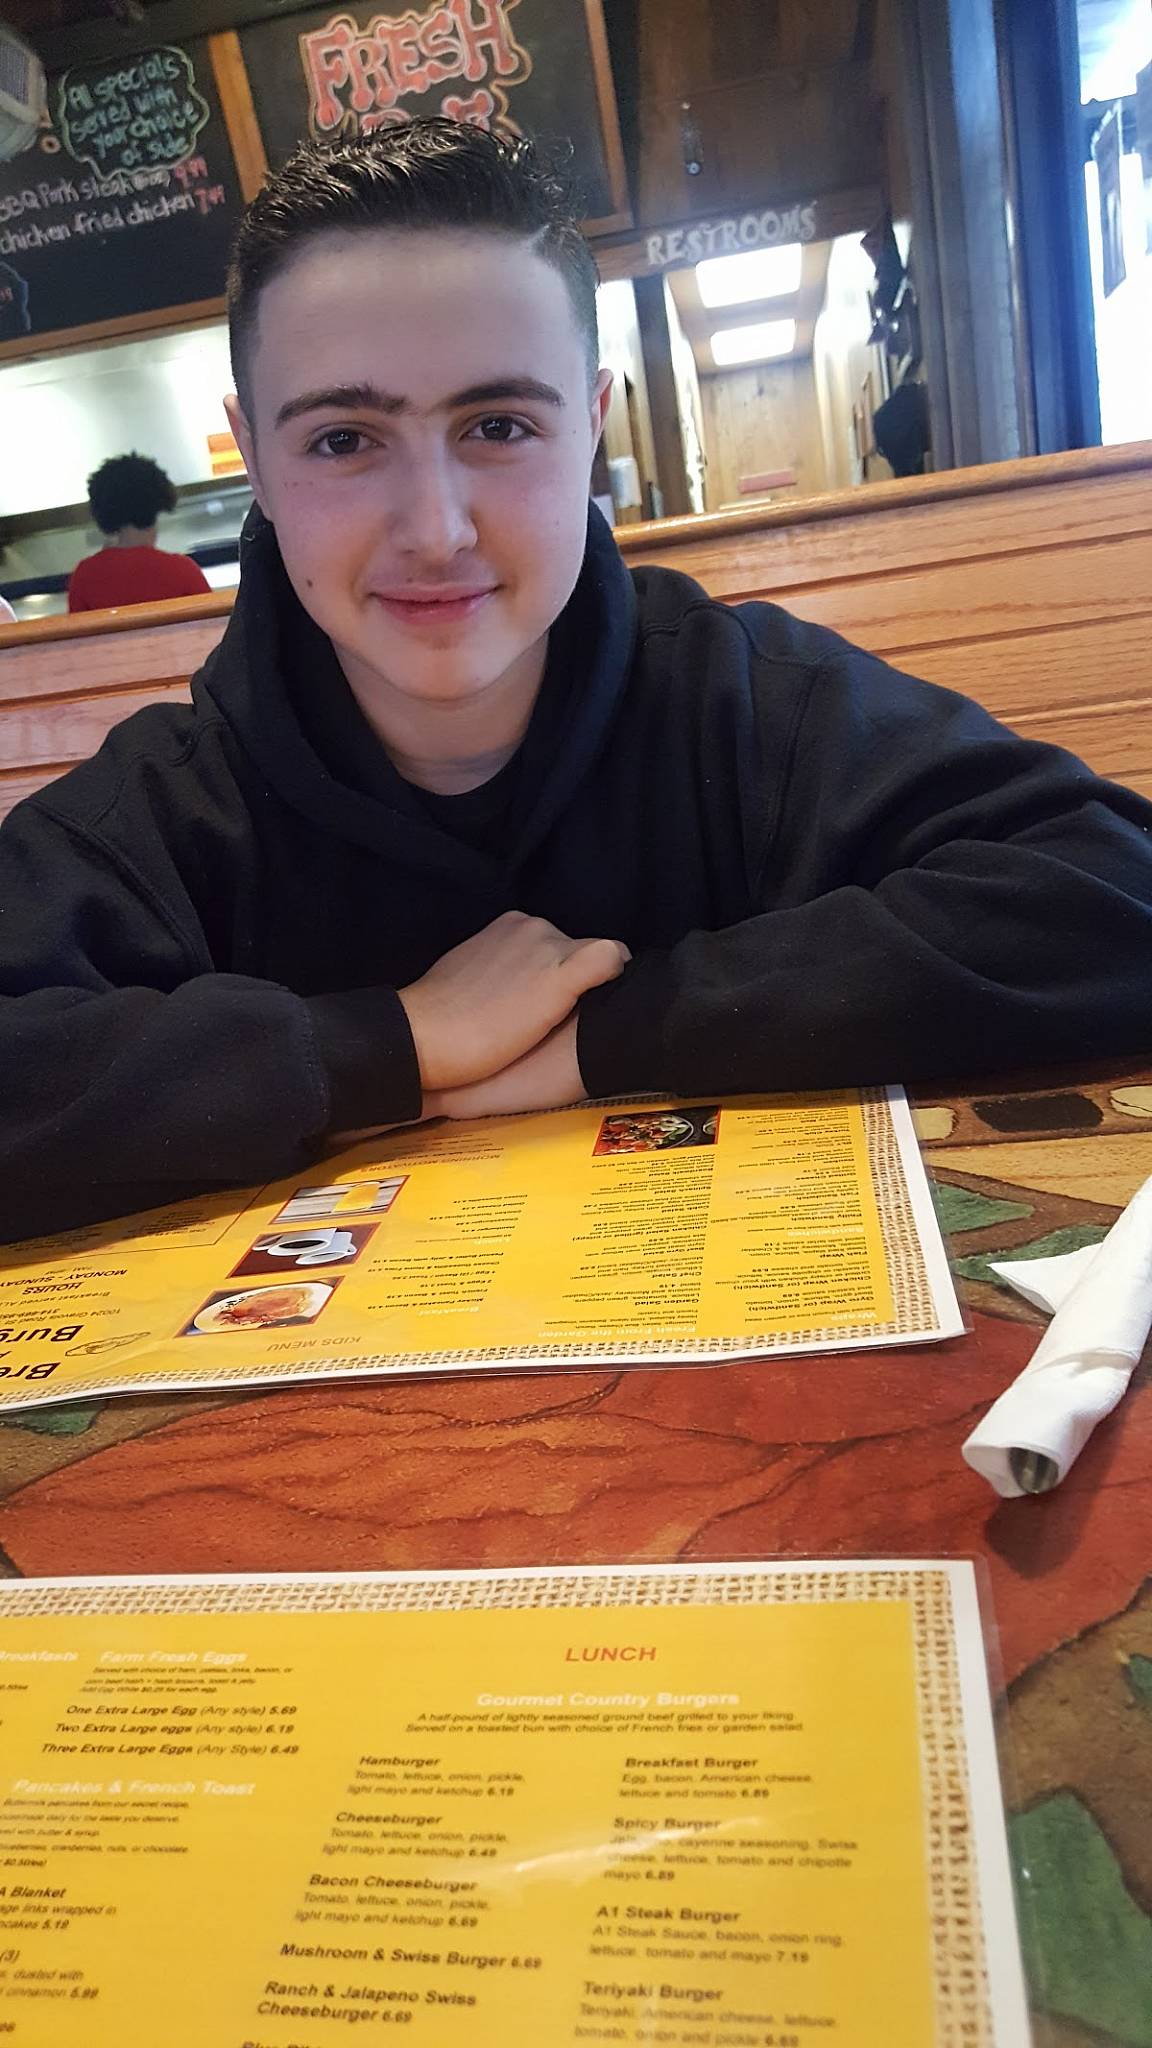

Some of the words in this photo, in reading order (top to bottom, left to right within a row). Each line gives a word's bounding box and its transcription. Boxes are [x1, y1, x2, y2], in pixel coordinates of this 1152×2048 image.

[307, 0, 519, 129] FRESH
[647, 200, 818, 265] RESTROOMS
[0, 1276, 55, 1287] SUNDAY
[64, 1270, 127, 1280] MONDAY
[22, 1283, 84, 1295] HOURS
[266, 1341, 317, 1351] MENU
[321, 1336, 361, 1345] KIDS
[99, 1650, 145, 1663] Farm
[149, 1650, 198, 1663] Fresh
[202, 1650, 248, 1666] Eggs
[565, 1647, 657, 1662] LUNCH
[476, 1693, 563, 1707] Gourmet
[568, 1692, 650, 1709] Country
[656, 1692, 740, 1708] Burgers
[66, 1704, 92, 1715] One
[95, 1704, 128, 1715] Extra
[131, 1704, 168, 1718] Large
[172, 1705, 198, 1718] Egg
[200, 1705, 228, 1718] (Any
[232, 1705, 265, 1718] style)
[418, 1713, 427, 1721] A
[430, 1713, 488, 1723] half-pound
[492, 1713, 504, 1721] of
[506, 1713, 538, 1723] lightly
[542, 1713, 599, 1721] seasoned
[603, 1713, 644, 1723] ground
[647, 1713, 674, 1721] beef
[677, 1713, 714, 1723] grilled
[717, 1713, 728, 1721] to
[732, 1714, 759, 1723] your
[56, 1722, 80, 1734] Two
[82, 1723, 116, 1734] Extra
[119, 1723, 157, 1737] Large
[160, 1725, 192, 1737] eggs
[195, 1724, 225, 1737] (Any
[228, 1724, 262, 1737] style)
[406, 1725, 446, 1733] Served
[477, 1725, 520, 1733] toasted
[523, 1725, 544, 1733] bun
[548, 1725, 571, 1733] with
[575, 1725, 613, 1733] choice
[617, 1724, 629, 1733] of
[632, 1724, 674, 1733] French
[678, 1724, 703, 1733] fries
[723, 1725, 766, 1735] garden
[769, 1724, 803, 1732] salad
[41, 1743, 77, 1754] Three
[79, 1743, 114, 1755] Extra
[117, 1743, 156, 1757] Large
[159, 1744, 193, 1758] Eggs
[196, 1744, 226, 1758] (Any
[229, 1744, 267, 1758] Style)
[359, 1756, 441, 1769] Hamburger
[625, 1758, 699, 1768] Breakfast
[704, 1758, 759, 1770] Burger
[701, 1774, 760, 1782] American
[13, 1779, 104, 1795] Pancakes
[108, 1780, 123, 1794] &
[129, 1781, 195, 1794] French
[203, 1781, 257, 1796] Toast
[347, 1786, 368, 1796] light
[371, 1787, 408, 1797] mayo
[411, 1787, 434, 1795] and
[437, 1787, 484, 1798] ketchup
[619, 1790, 660, 1799] lettuce
[665, 1790, 689, 1799] and
[693, 1790, 738, 1799] tomato
[336, 1812, 443, 1827] Cheeseburger
[614, 1818, 657, 1831] Spicy
[663, 1818, 721, 1832] Burger
[309, 1874, 359, 1887] Bacon
[364, 1876, 478, 1893] Cheeseburger
[10, 1886, 66, 1899] Blanket
[626, 1906, 674, 1919] Steak
[680, 1908, 742, 1925] Burger
[280, 1943, 369, 1960] Mushroom
[373, 1948, 386, 1961] &
[391, 1949, 441, 1964] Swiss
[446, 1952, 507, 1970] Burger
[265, 1981, 319, 1997] Ranch
[323, 1985, 336, 1999] &
[425, 1990, 478, 2007] Swiss
[660, 1985, 724, 2004] Burger
[257, 2001, 379, 2024] Cheeseburger
